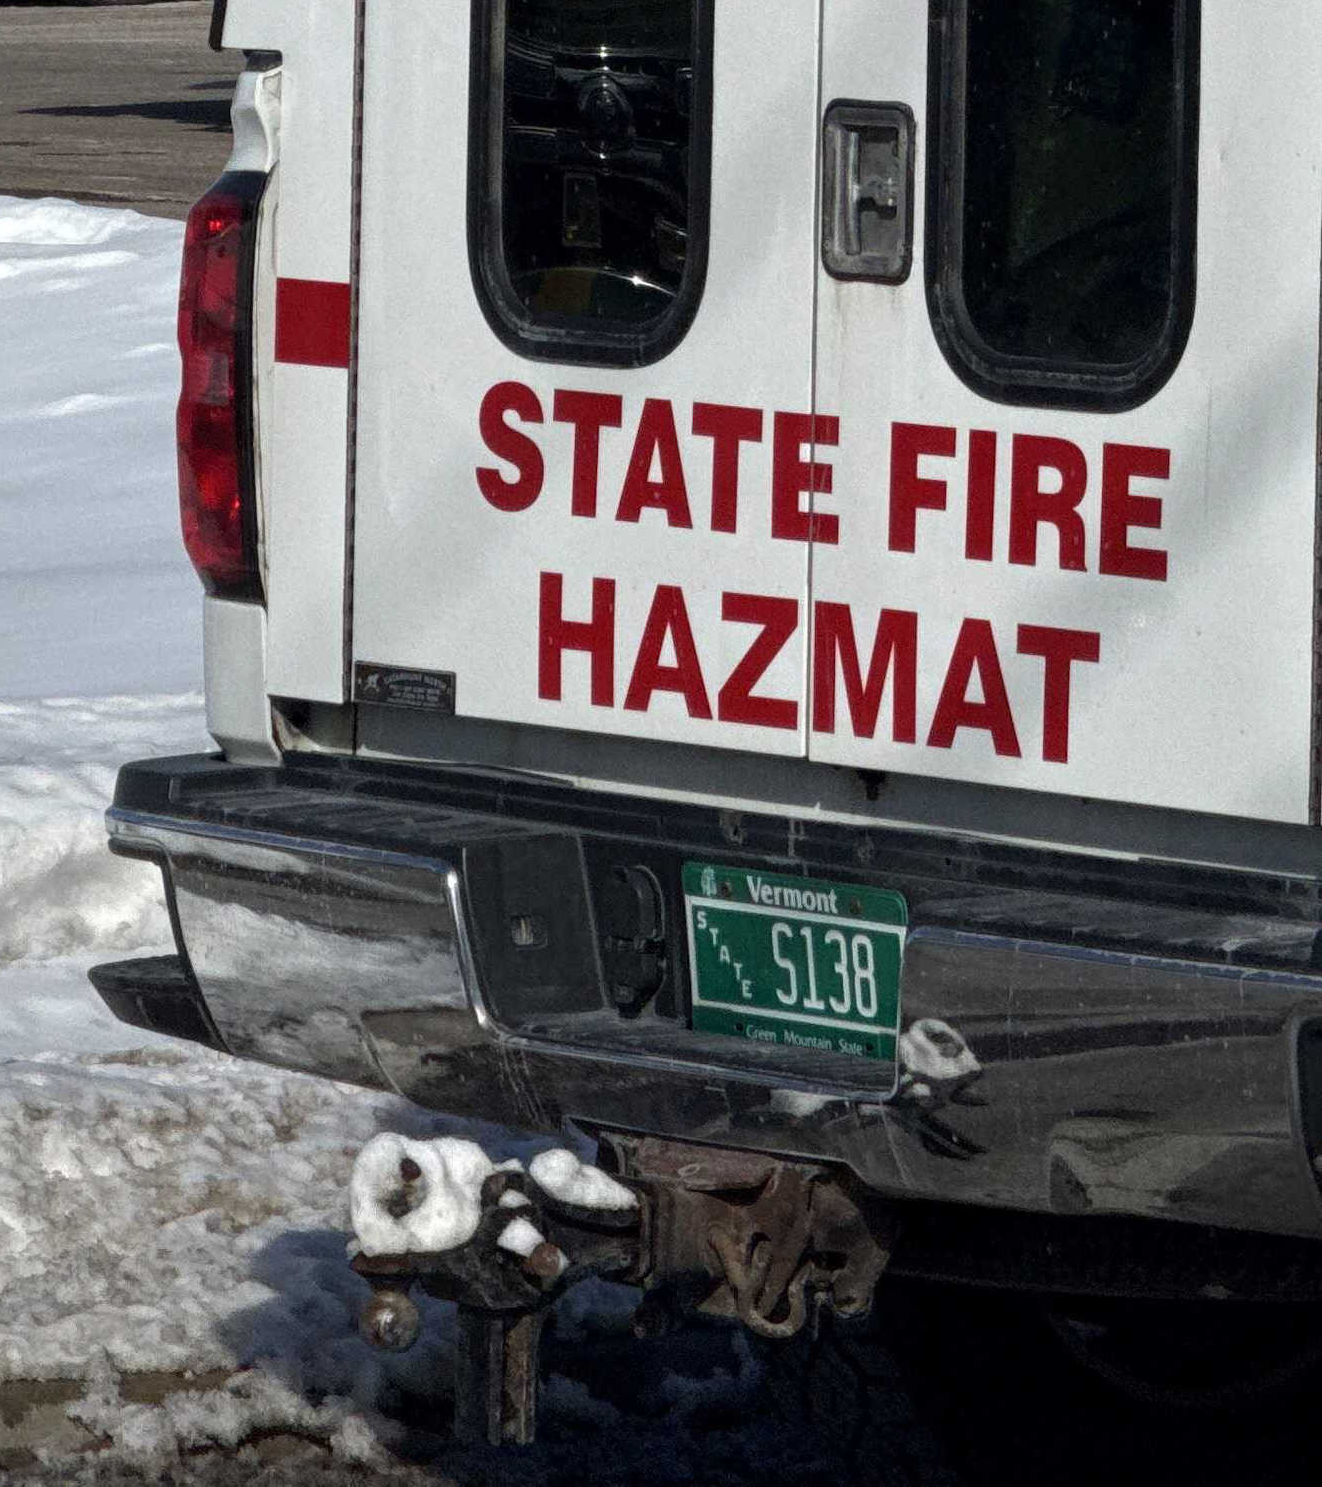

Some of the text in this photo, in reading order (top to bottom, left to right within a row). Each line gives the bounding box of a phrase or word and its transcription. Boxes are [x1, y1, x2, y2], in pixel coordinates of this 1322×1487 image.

[475, 380, 1171, 582] STATE FIRE
[538, 571, 1101, 764] HAZMAT
[746, 875, 838, 914] Vermont
[696, 910, 752, 999] STATE
[771, 922, 878, 1018] S138
[745, 1024, 863, 1056] Green Mountain State
